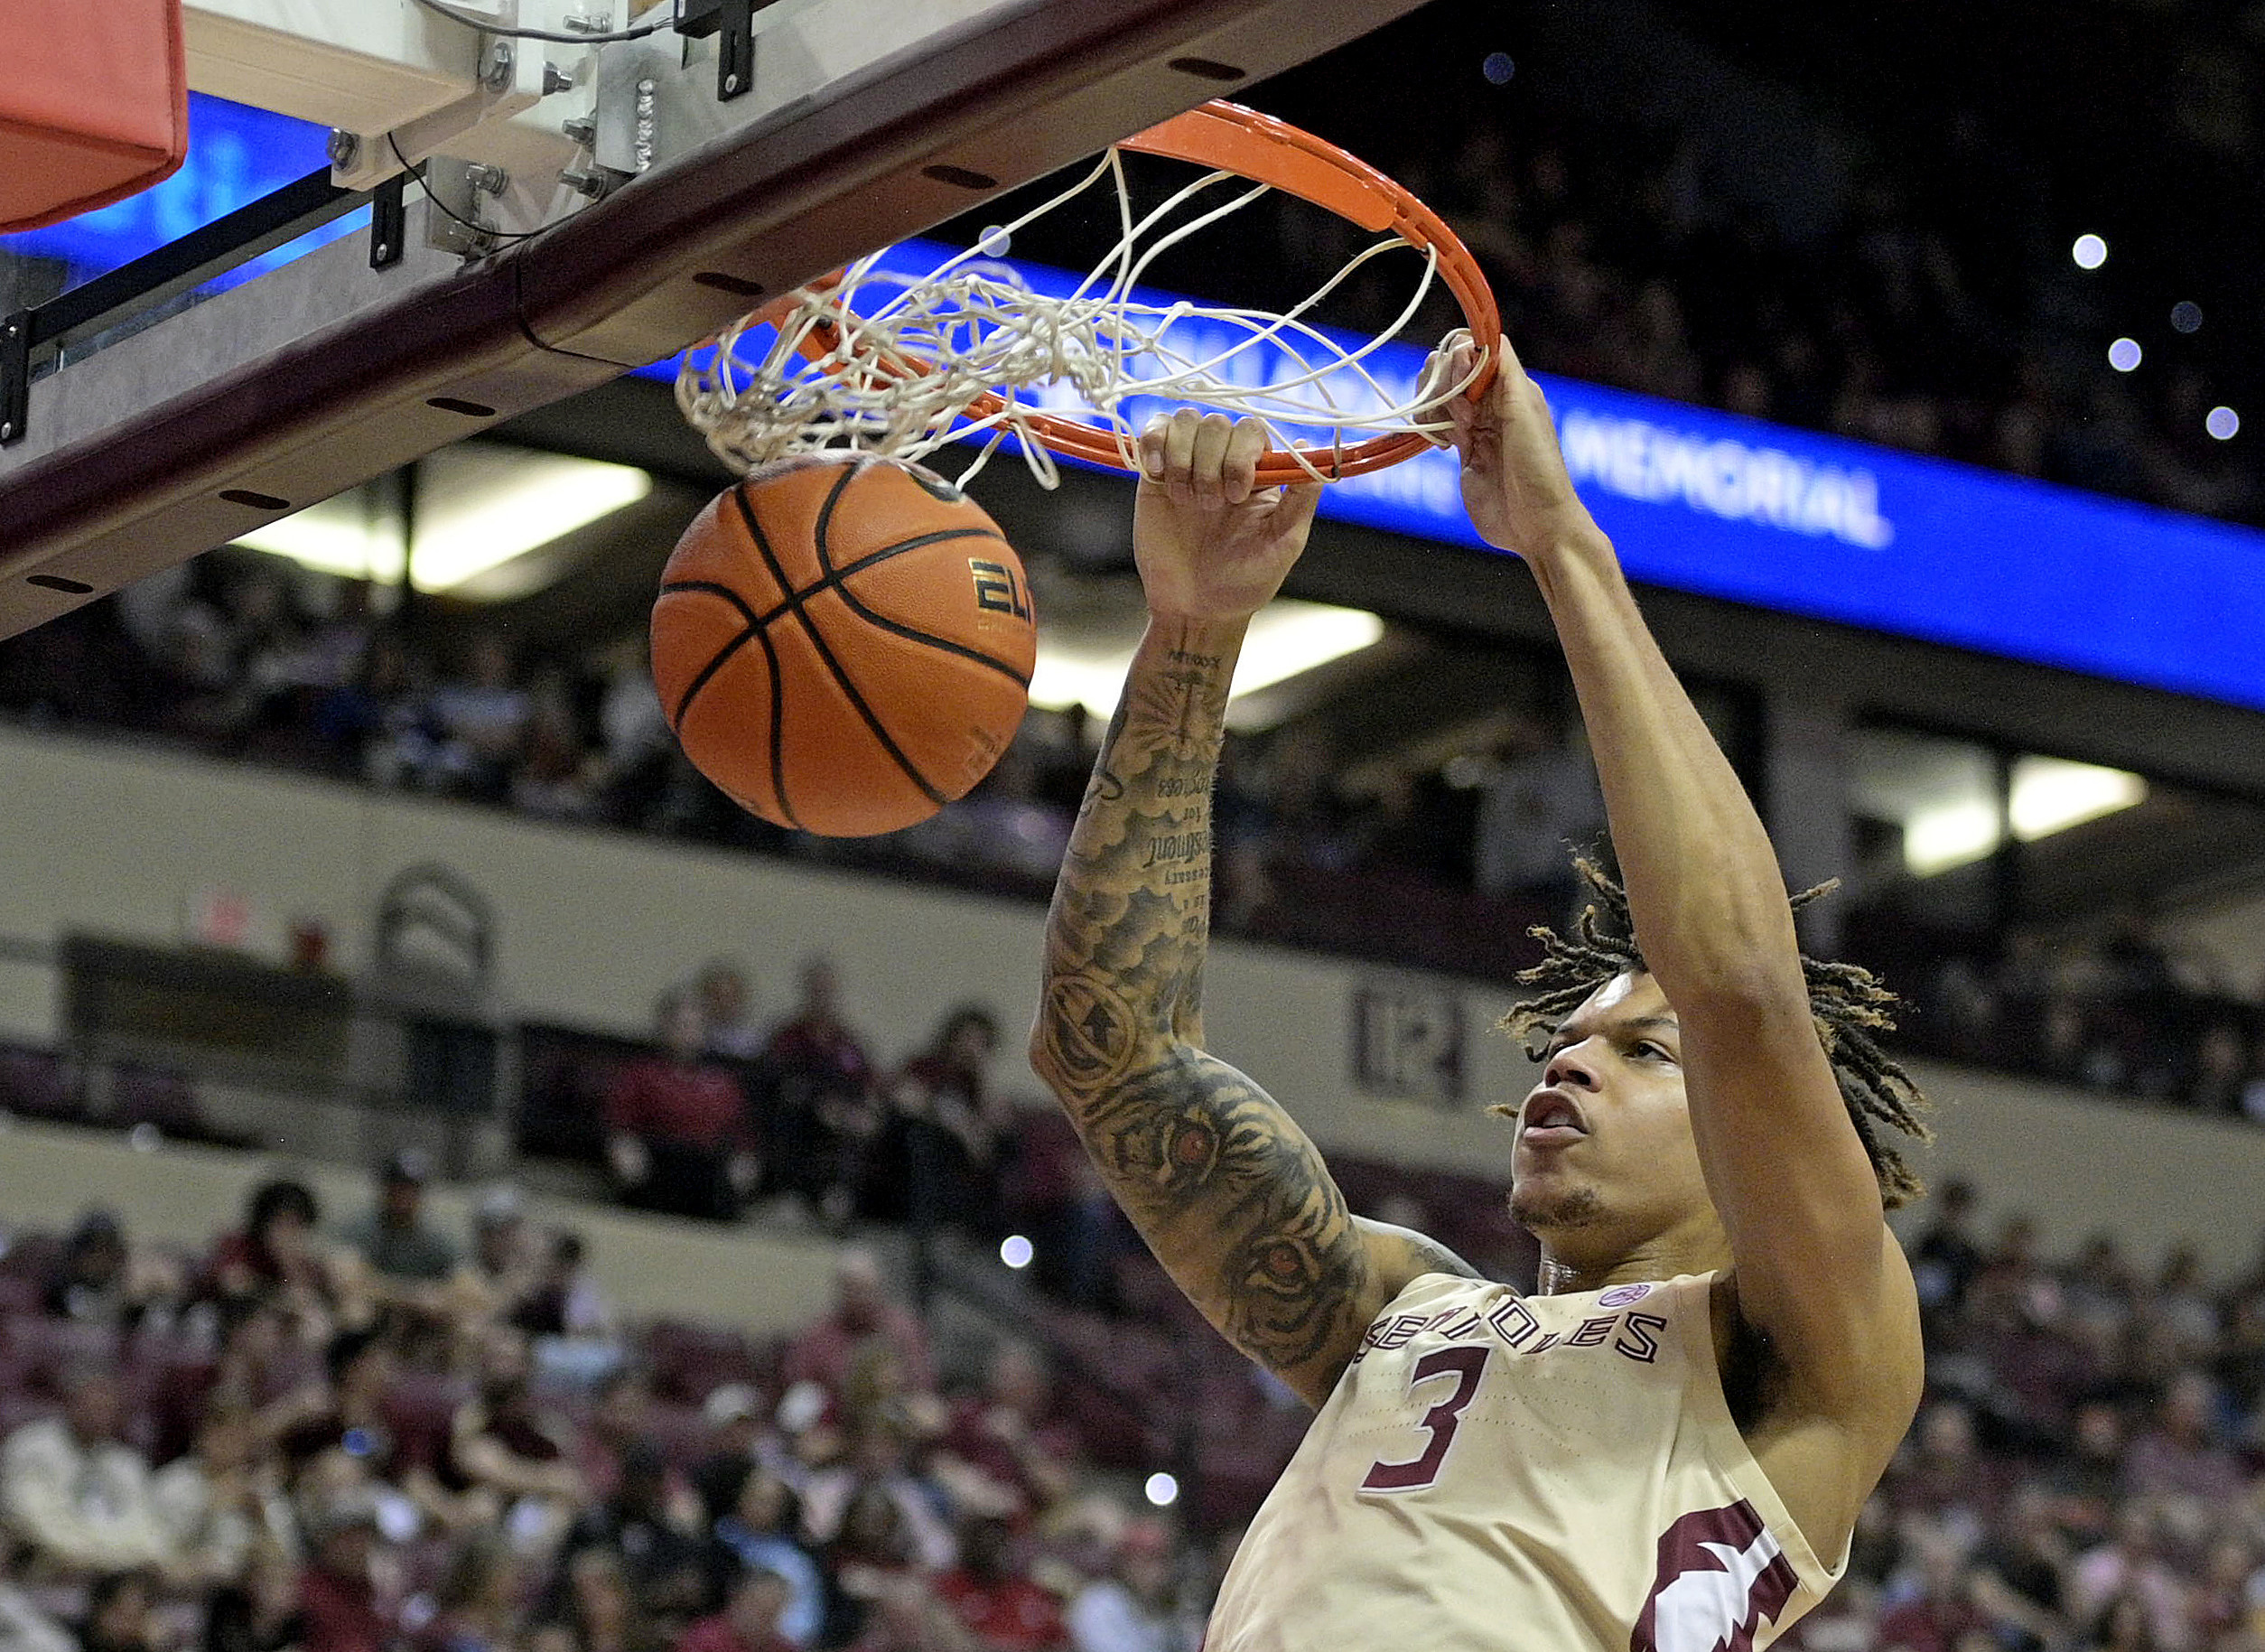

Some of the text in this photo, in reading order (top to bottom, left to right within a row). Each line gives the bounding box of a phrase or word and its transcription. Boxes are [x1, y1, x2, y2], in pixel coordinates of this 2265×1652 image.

[1562, 411, 1894, 550] MEMORIAL
[968, 556, 1030, 625] EL
[1355, 1299, 1666, 1363] SEIOLES
[1358, 1343, 1496, 1493] 3
